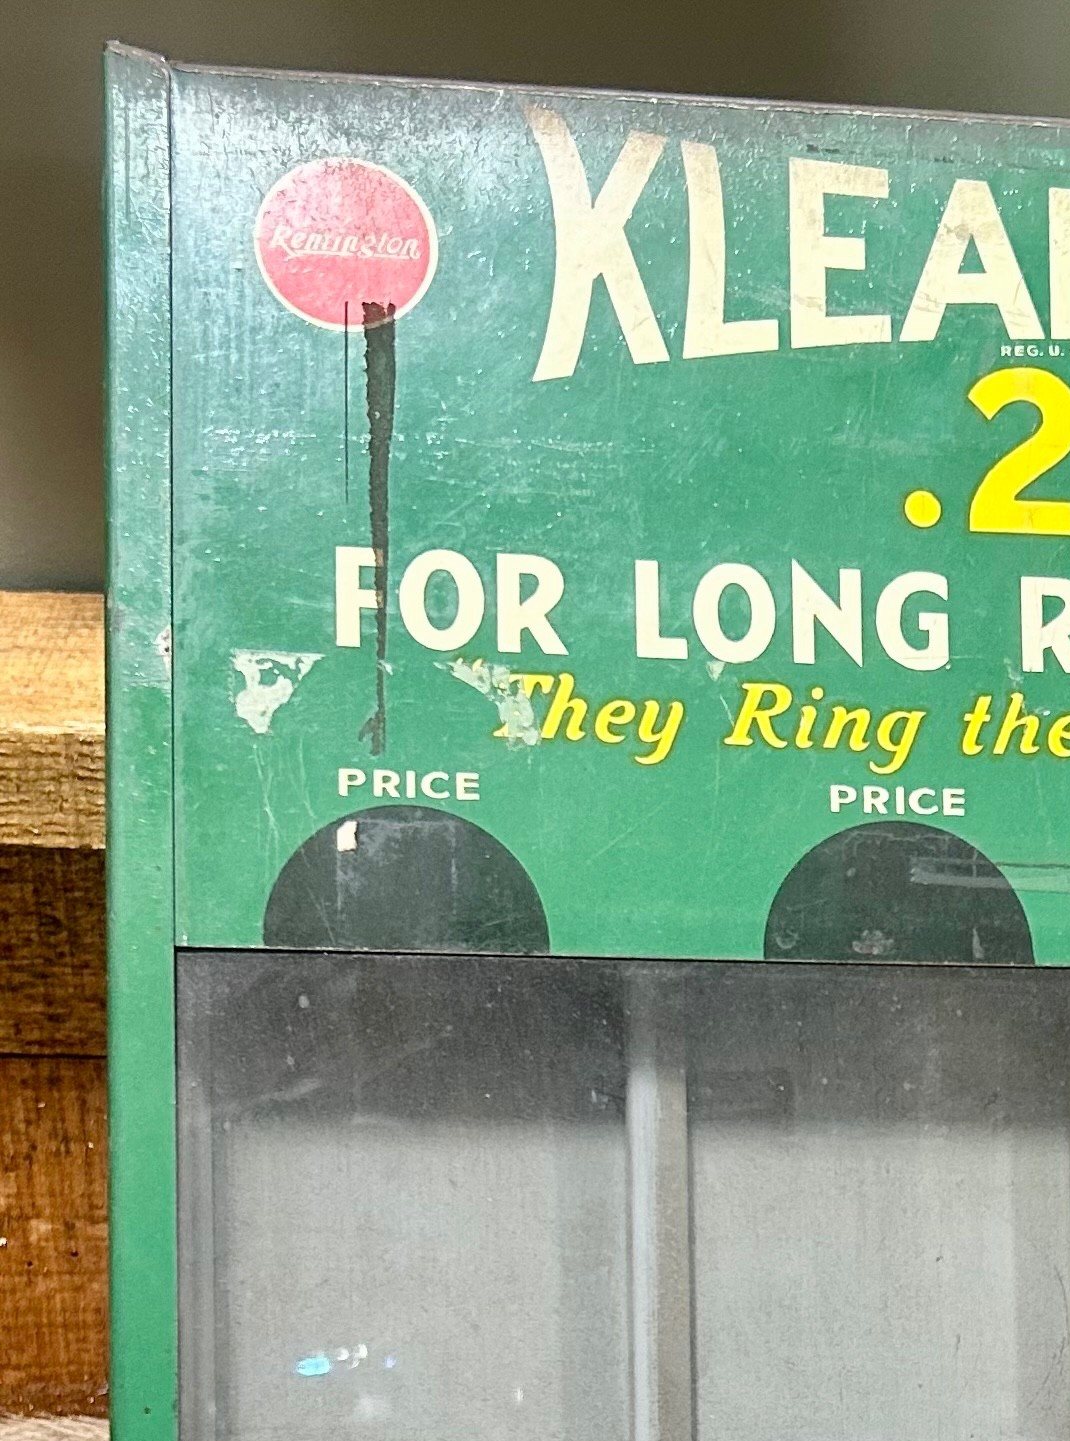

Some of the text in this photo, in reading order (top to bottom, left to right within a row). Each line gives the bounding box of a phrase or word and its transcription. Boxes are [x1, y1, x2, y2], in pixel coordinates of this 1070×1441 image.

[269, 224, 422, 262] Remington
[1000, 344, 1044, 357] REG.
[335, 546, 569, 656] FOR
[635, 559, 950, 671] LONG
[723, 682, 927, 774] Ring
[337, 768, 481, 800] PRICE
[830, 784, 966, 816] PRICE
